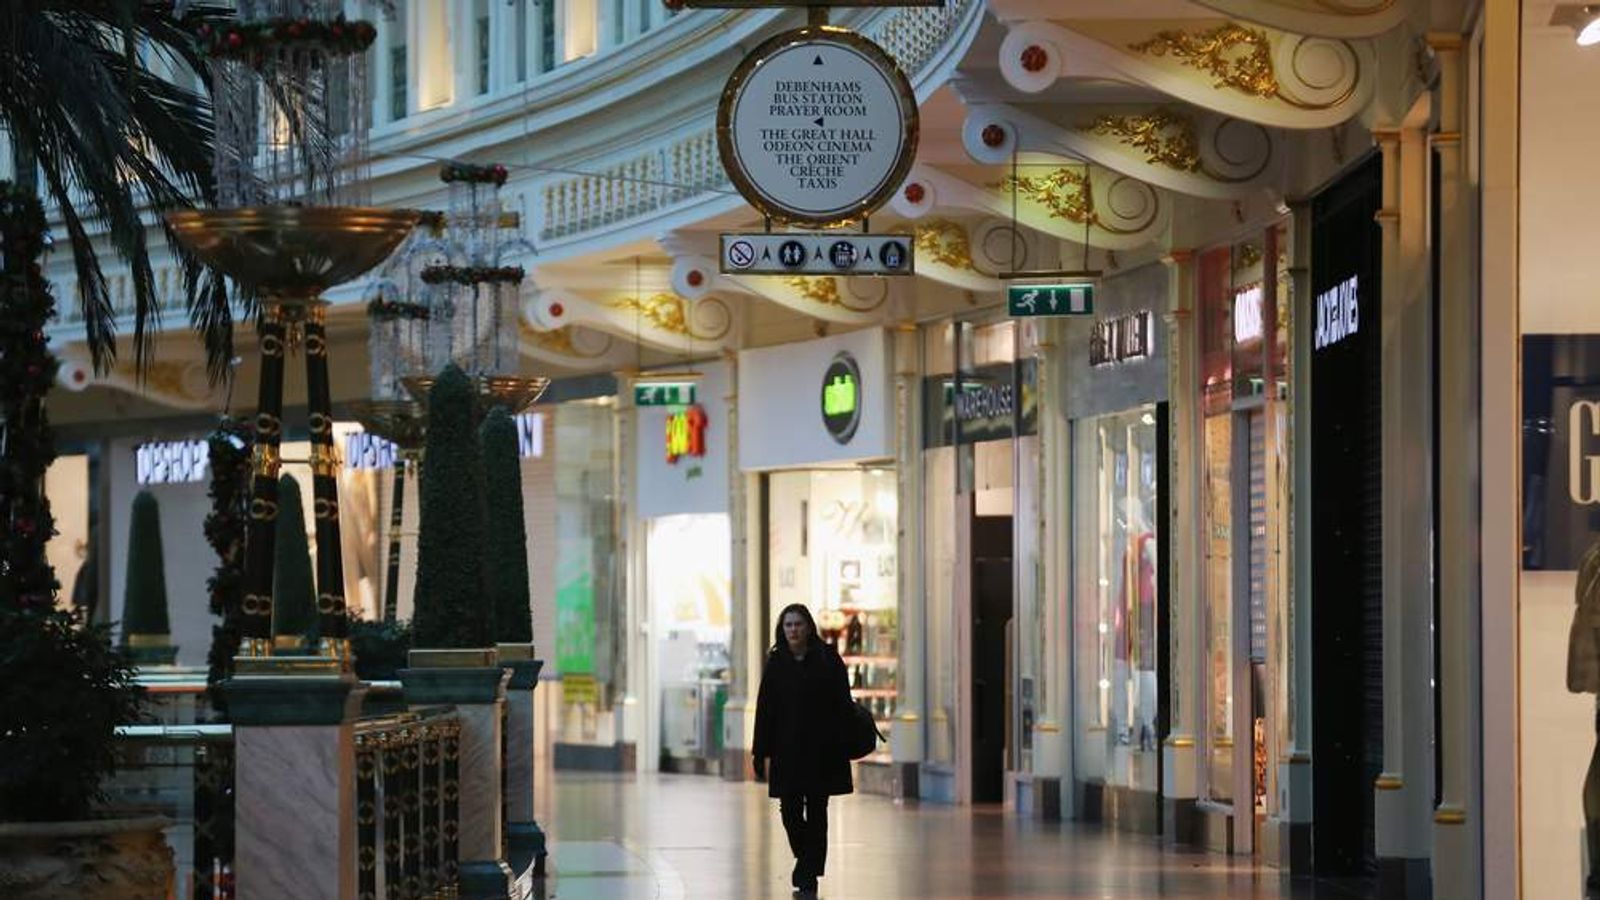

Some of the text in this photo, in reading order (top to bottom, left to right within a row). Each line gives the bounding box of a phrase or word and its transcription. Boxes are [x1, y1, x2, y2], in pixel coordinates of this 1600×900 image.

[776, 81, 861, 92] DEBENHAMS
[774, 93, 862, 104] BUS STATION
[769, 105, 867, 116] PRAYER ROOM
[761, 129, 876, 140] THE GREAT HALL
[763, 141, 872, 152] ODEON CINEMA
[776, 154, 859, 165] THE ORIENT
[798, 178, 838, 189] TAXIS
